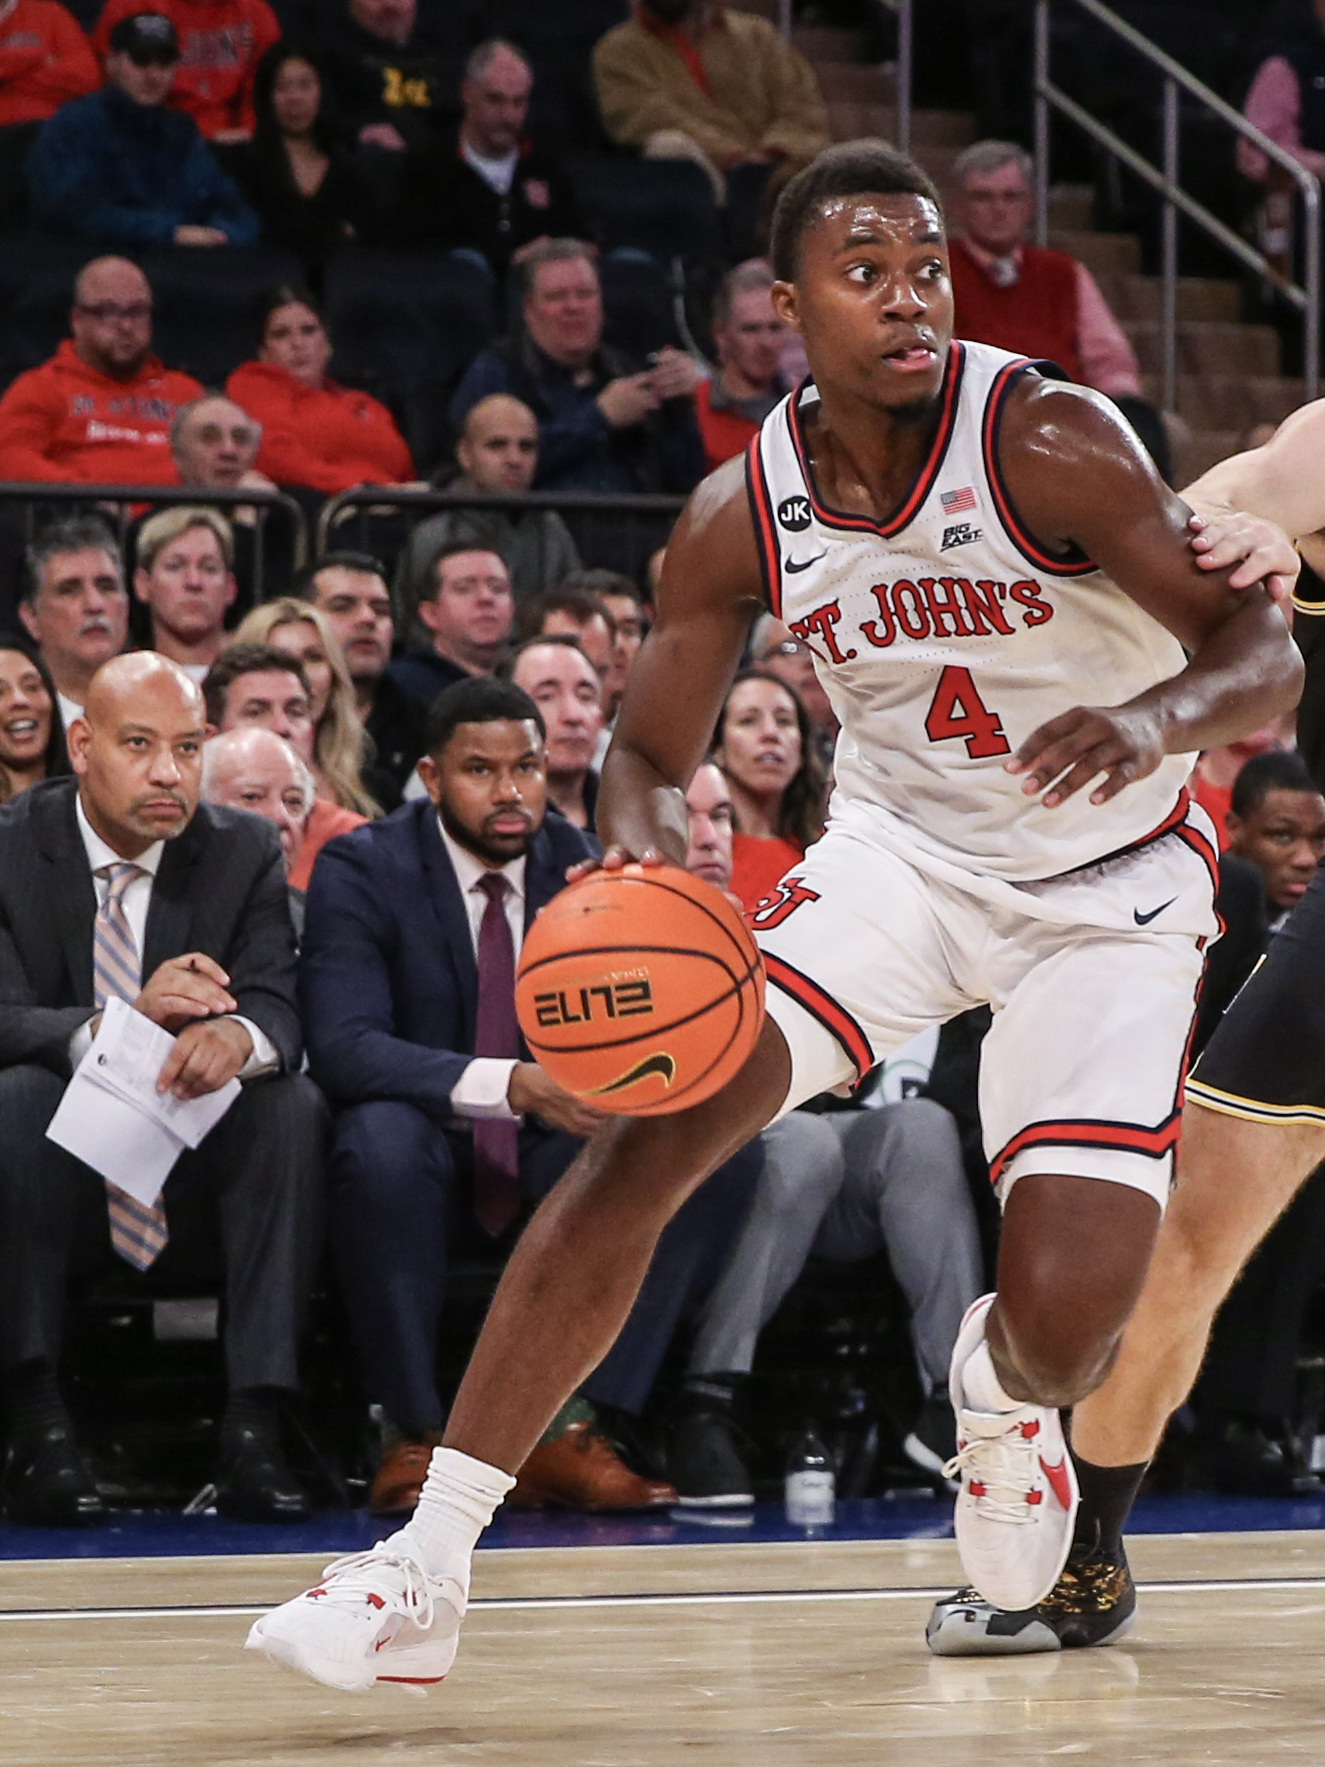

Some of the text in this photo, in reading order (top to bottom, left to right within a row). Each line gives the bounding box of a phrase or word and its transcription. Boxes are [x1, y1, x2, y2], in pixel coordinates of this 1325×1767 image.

[780, 500, 809, 521] JK
[941, 529, 982, 548] EAST
[942, 523, 971, 538] BIG
[859, 577, 1054, 648] JOHN'S
[924, 665, 1012, 760] 4
[534, 979, 654, 1027] ELITE
